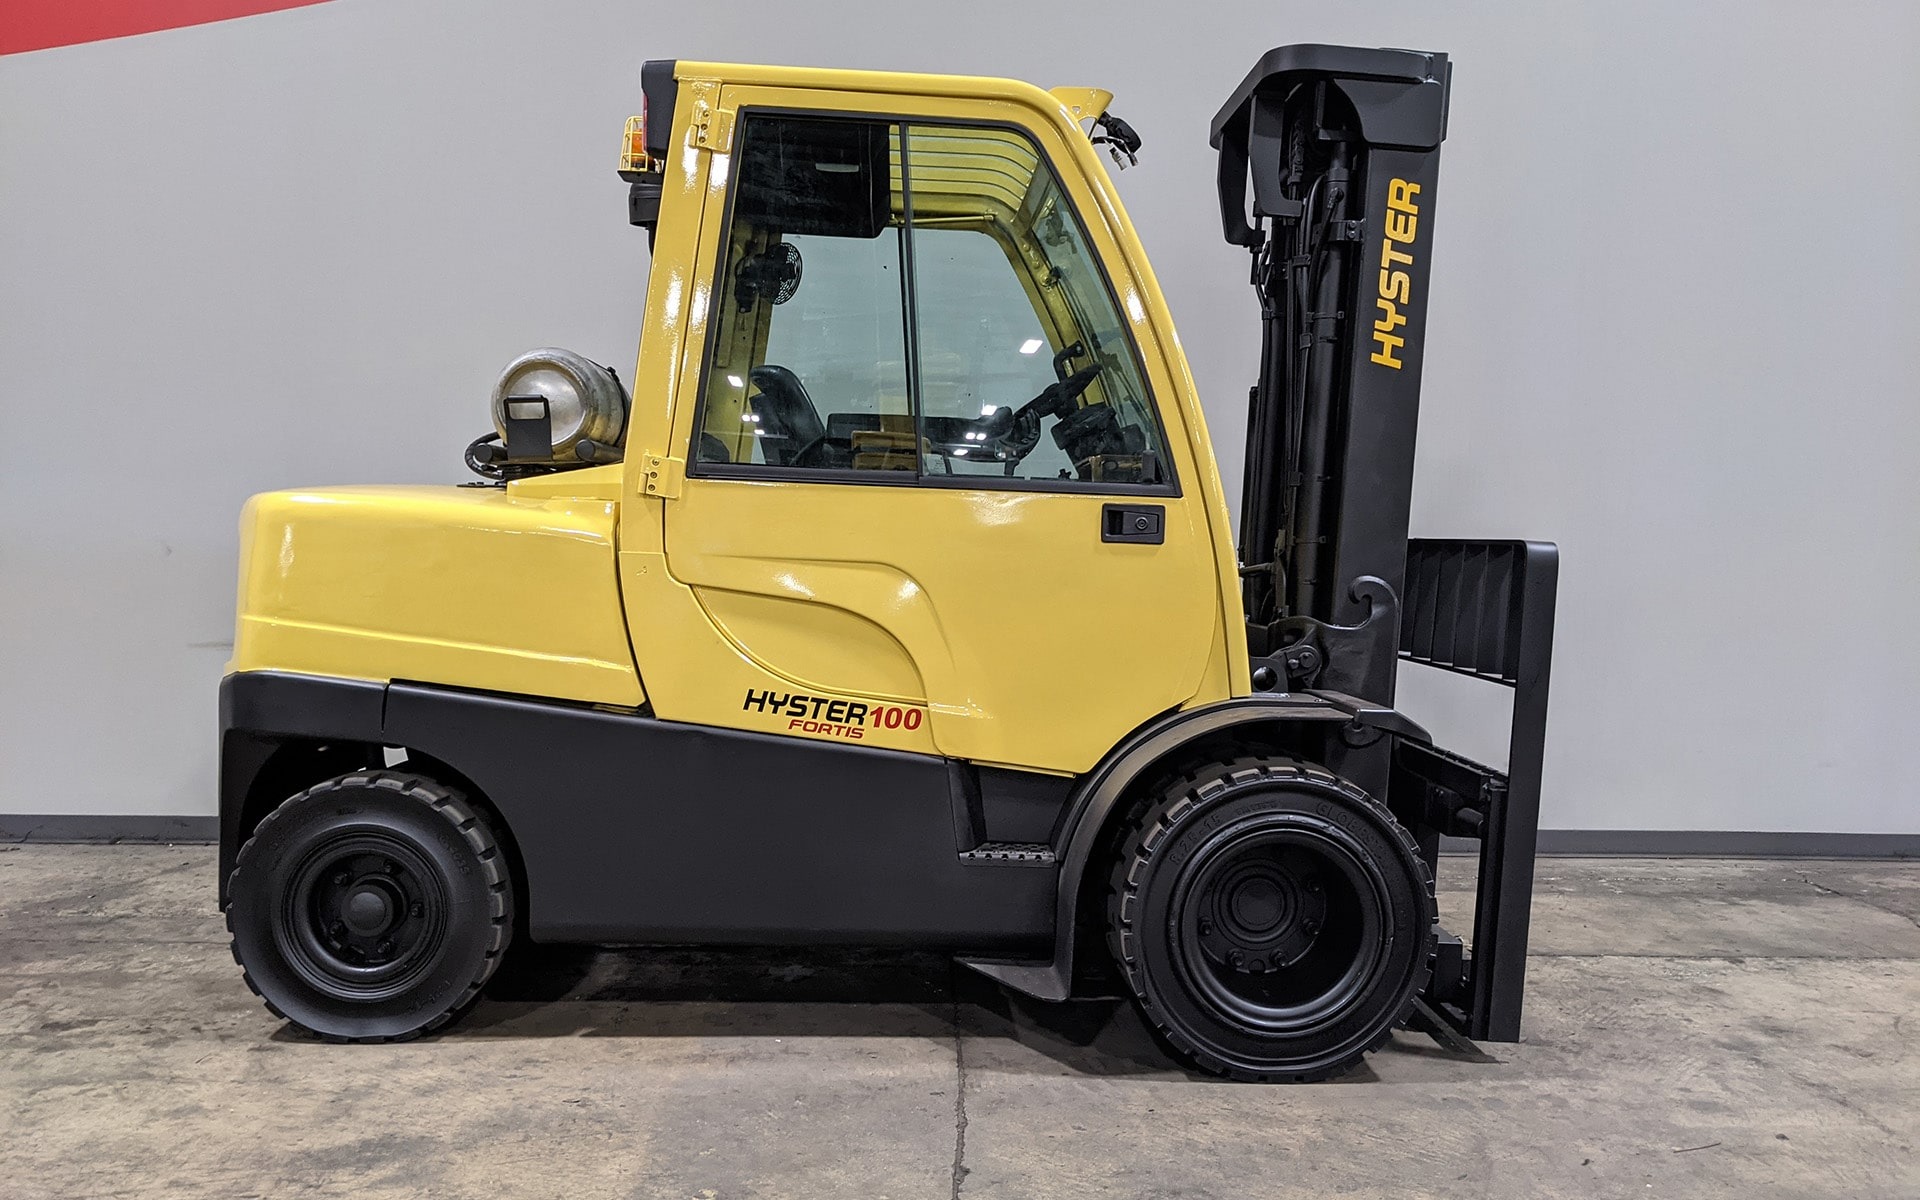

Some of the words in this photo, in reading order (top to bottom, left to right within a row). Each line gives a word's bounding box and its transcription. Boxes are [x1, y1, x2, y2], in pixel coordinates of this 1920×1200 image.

[1371, 178, 1420, 369] HYSTER
[743, 689, 868, 725] HYSTER
[870, 706, 922, 730] 100
[788, 719, 865, 739] FORTIS
